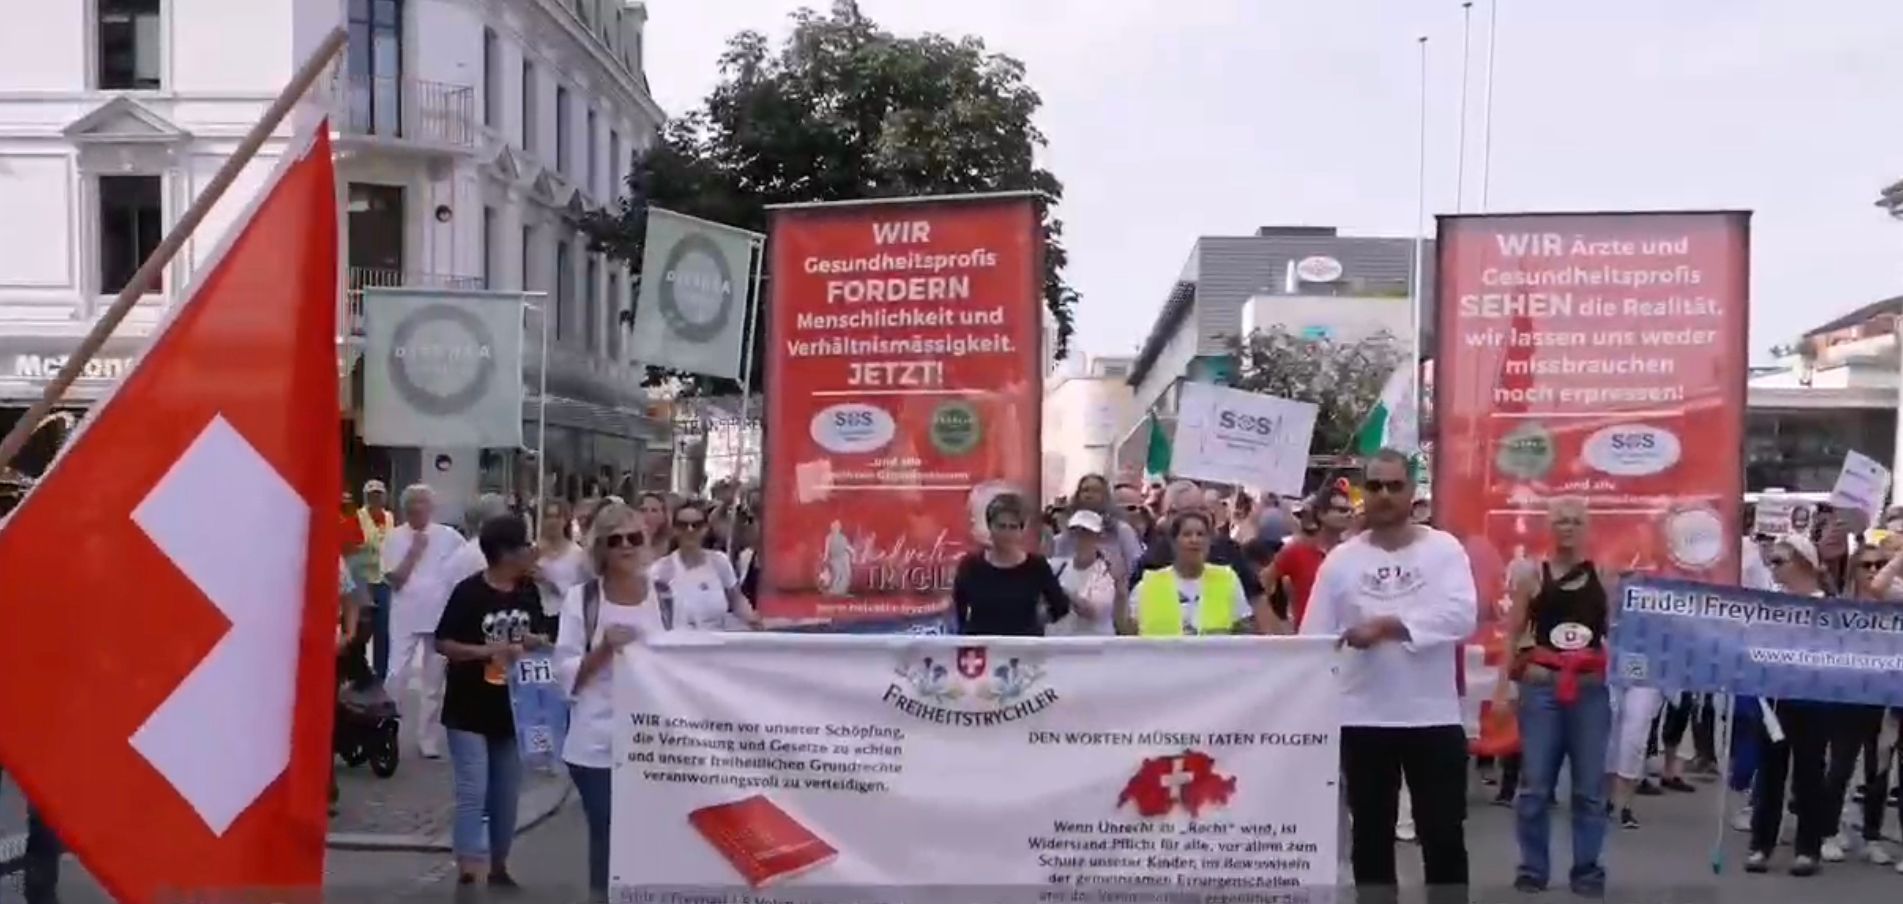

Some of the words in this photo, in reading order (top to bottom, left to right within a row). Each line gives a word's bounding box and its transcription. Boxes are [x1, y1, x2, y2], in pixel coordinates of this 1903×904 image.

[872, 221, 931, 245] WIR
[1496, 233, 1563, 257] WIR
[1570, 234, 1634, 256] Ärzte
[1641, 236, 1688, 255] und
[804, 248, 996, 274] Gesundheitsprofis
[1482, 265, 1701, 288] Gesundheitsprofis
[827, 276, 969, 303] FORDERN
[1459, 293, 1572, 318] SEHEN
[1579, 297, 1617, 317] die
[797, 307, 954, 331] Menschlichkeit
[960, 306, 1004, 325] und
[787, 333, 1015, 357] Verhältnismässigkeit.
[1465, 328, 1503, 347] wir
[1511, 328, 1585, 347] lassen
[1593, 331, 1632, 347] uns
[1640, 328, 1716, 346] weder
[848, 361, 943, 386] JETZT!
[1505, 355, 1674, 376] missbrauchen
[1494, 385, 1553, 404] noch
[1559, 385, 1684, 405] erpressen!
[835, 411, 873, 427] SOS
[1219, 410, 1273, 435] SOS
[1611, 433, 1655, 450] SOS
[1625, 588, 1694, 614] Fride!
[1704, 599, 1811, 625] Freyheit!
[519, 658, 551, 682] Fri
[882, 683, 1059, 729] FREIHEITSTRYCHLER
[630, 712, 660, 727] WIR
[665, 718, 733, 732] schwören
[737, 723, 759, 733] vor
[765, 724, 820, 736] unserer
[825, 723, 905, 740] Schöpfung,
[1028, 732, 1061, 745] DEN
[1064, 732, 1132, 745] WORTEN
[1137, 730, 1201, 746] MÜSSEN
[1207, 732, 1254, 746] TATEN
[1260, 733, 1328, 746] FOLGEN!
[632, 732, 654, 744] die
[658, 732, 734, 751] Verfassung
[739, 739, 765, 751] und
[770, 739, 828, 754] Gesetze
[833, 744, 849, 755] zu
[855, 743, 902, 756] achten
[628, 751, 654, 763] und
[659, 753, 705, 766] unsere
[810, 759, 902, 773] Grundrechte
[643, 770, 779, 788] verantwortungsvoll
[783, 778, 799, 789] zu
[804, 778, 889, 793] verteidigen.
[1053, 820, 1093, 833] Wenn
[1098, 820, 1154, 834] Unrecht
[1159, 822, 1175, 833] zu
[1240, 822, 1277, 836] wird,
[1281, 823, 1297, 834] ist
[1028, 836, 1107, 850] Widerstand
[1112, 838, 1156, 850] Pflicht
[1160, 838, 1179, 850] für
[1184, 838, 1214, 852] alle,
[1218, 841, 1241, 852] vor
[1245, 840, 1283, 852] allem
[1286, 841, 1318, 853] zum
[1146, 855, 1197, 870] Kinder,
[1048, 874, 1071, 883] der
